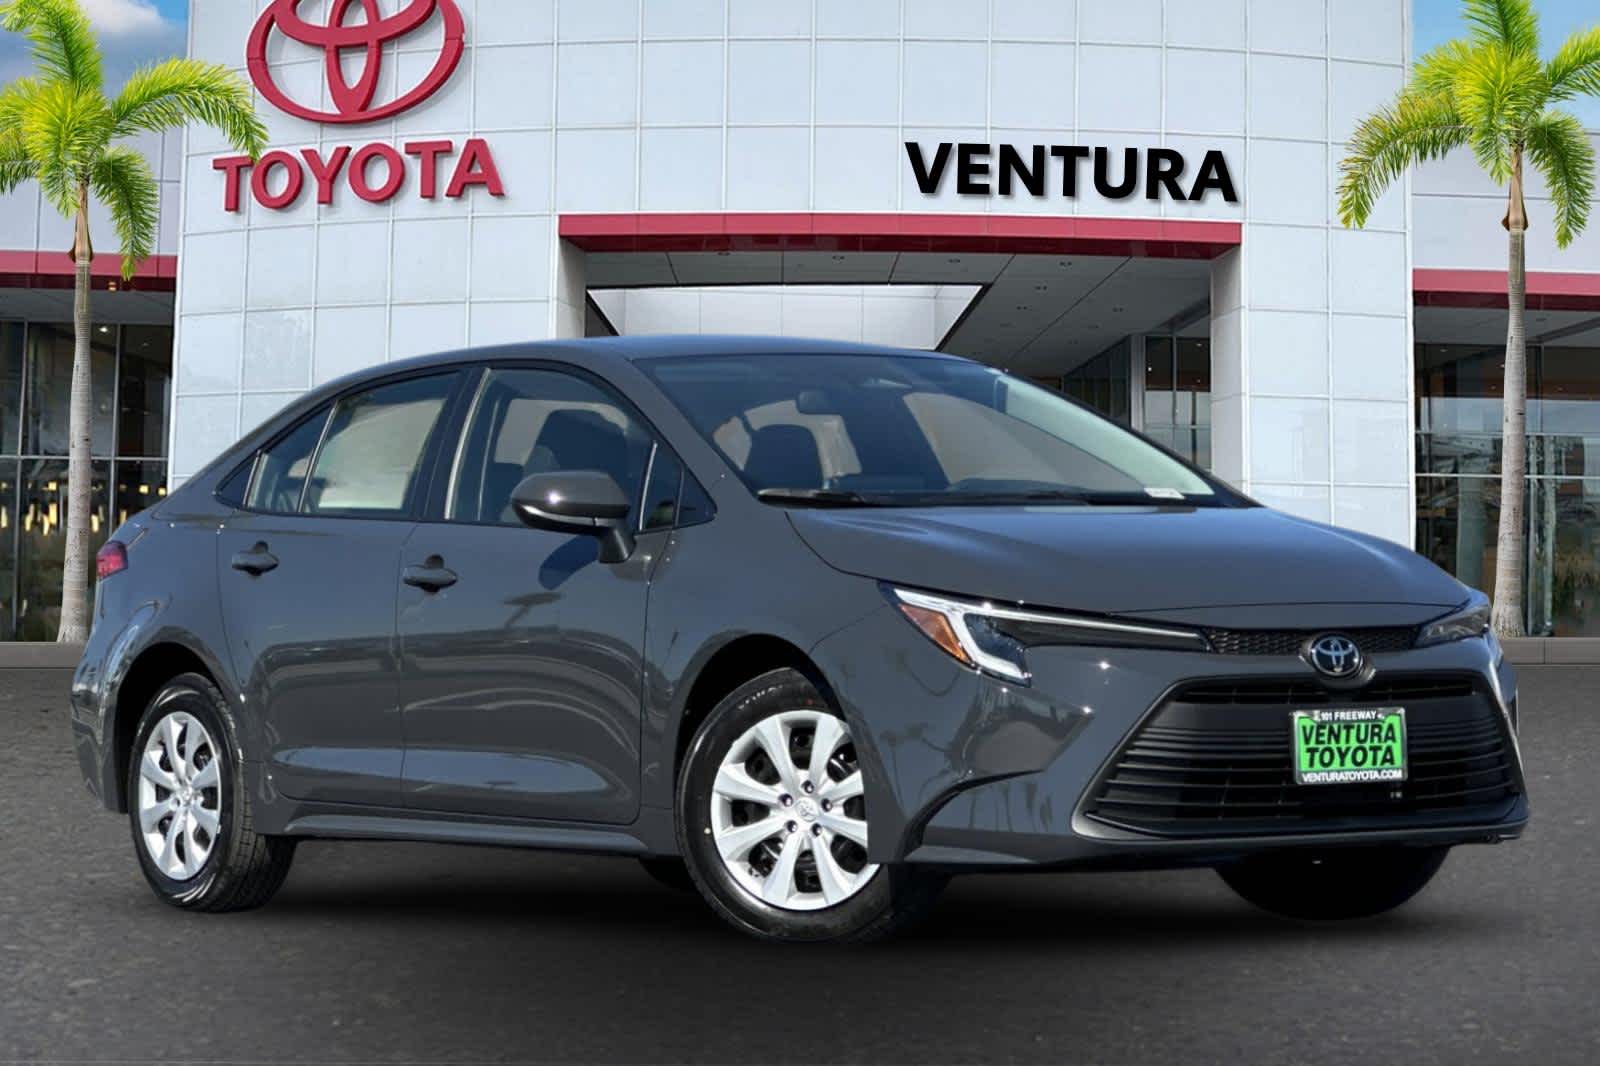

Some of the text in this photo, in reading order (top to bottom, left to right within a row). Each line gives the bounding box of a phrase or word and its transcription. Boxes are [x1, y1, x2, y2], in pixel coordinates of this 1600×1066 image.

[212, 138, 505, 213] TOYOTA
[904, 141, 1238, 203] VENTURA
[1334, 711, 1377, 721] FREEWAY
[1302, 723, 1396, 745] VENTURA
[1305, 745, 1395, 768] TOYOTA
[1302, 769, 1403, 783] VENTURATOYOTA.COM
